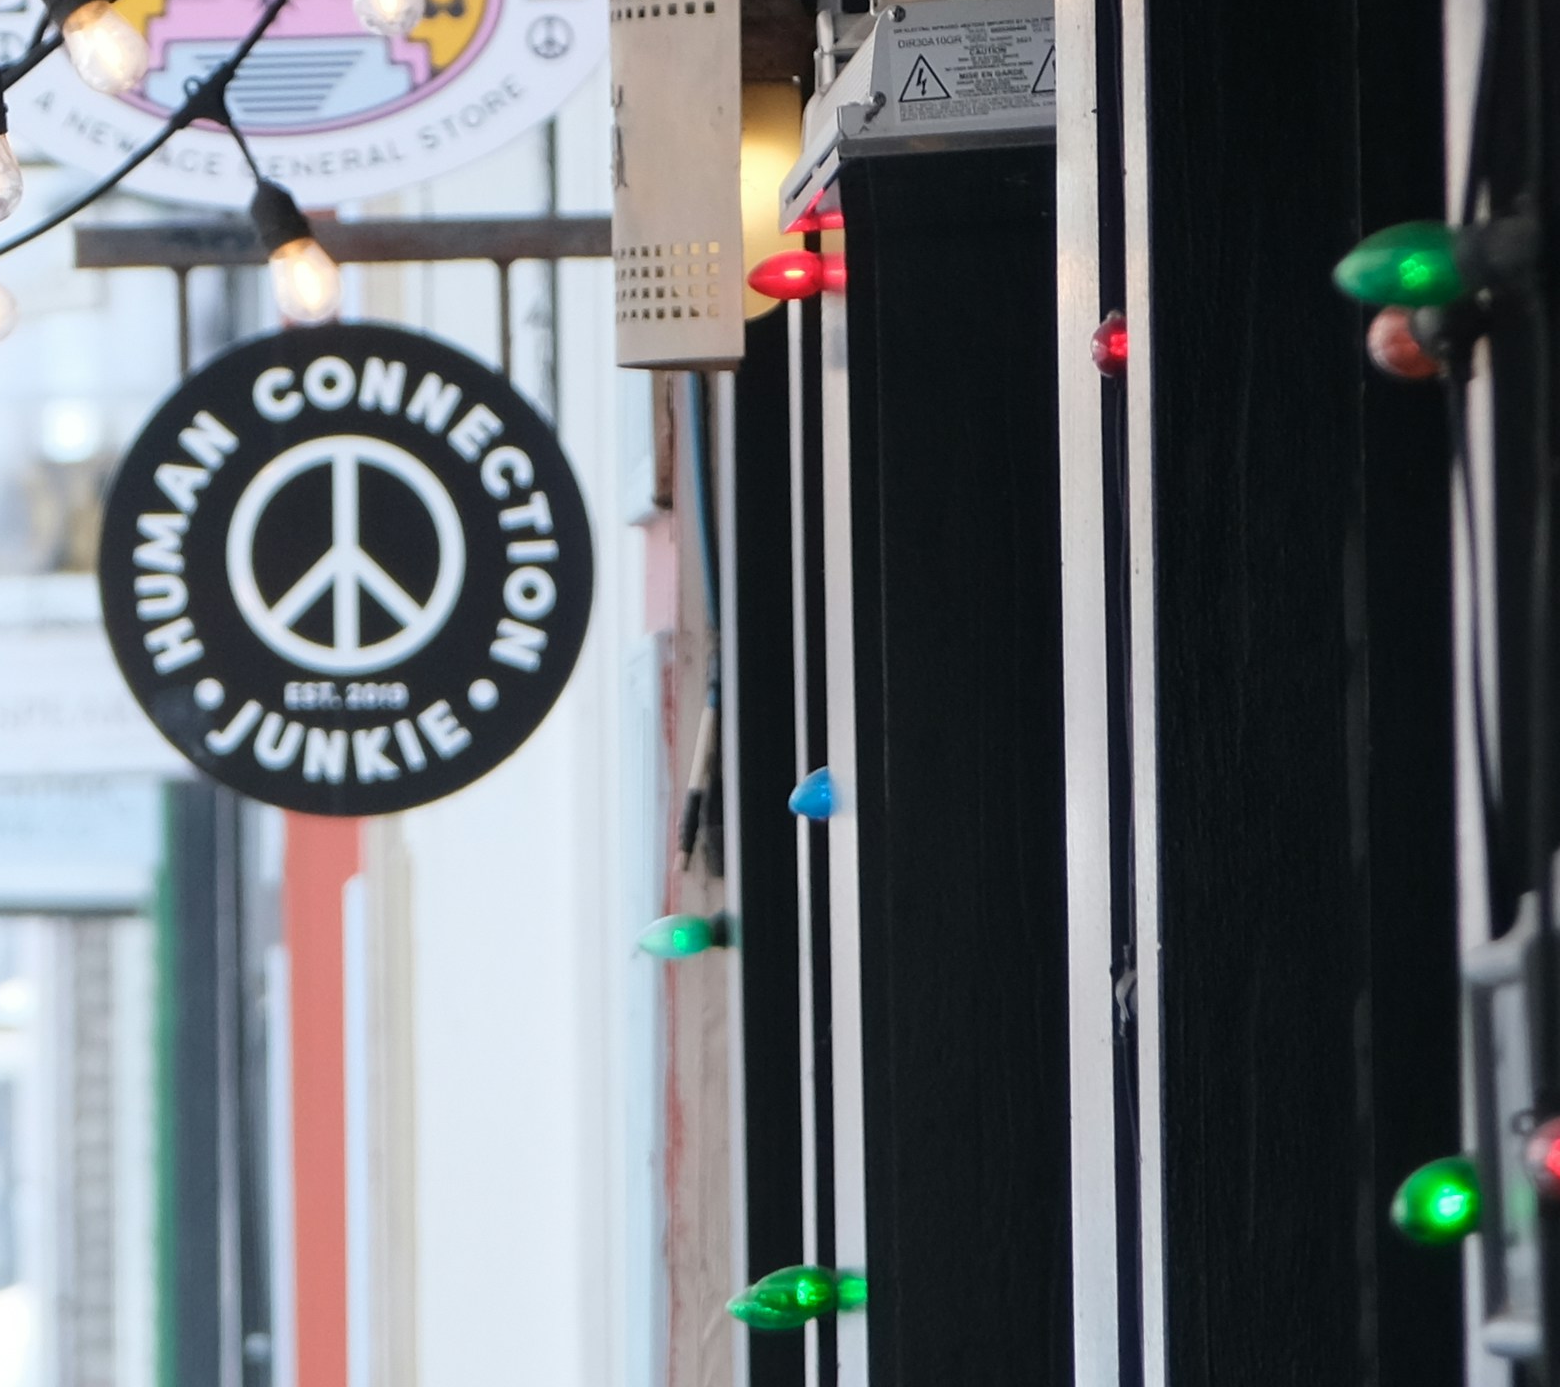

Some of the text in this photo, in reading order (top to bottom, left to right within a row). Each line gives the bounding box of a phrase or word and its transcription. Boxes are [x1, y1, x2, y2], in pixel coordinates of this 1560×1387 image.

[416, 72, 526, 152] STORE
[132, 355, 561, 675] HUMAN CONNECTION
[205, 699, 472, 784] JUNKIE
